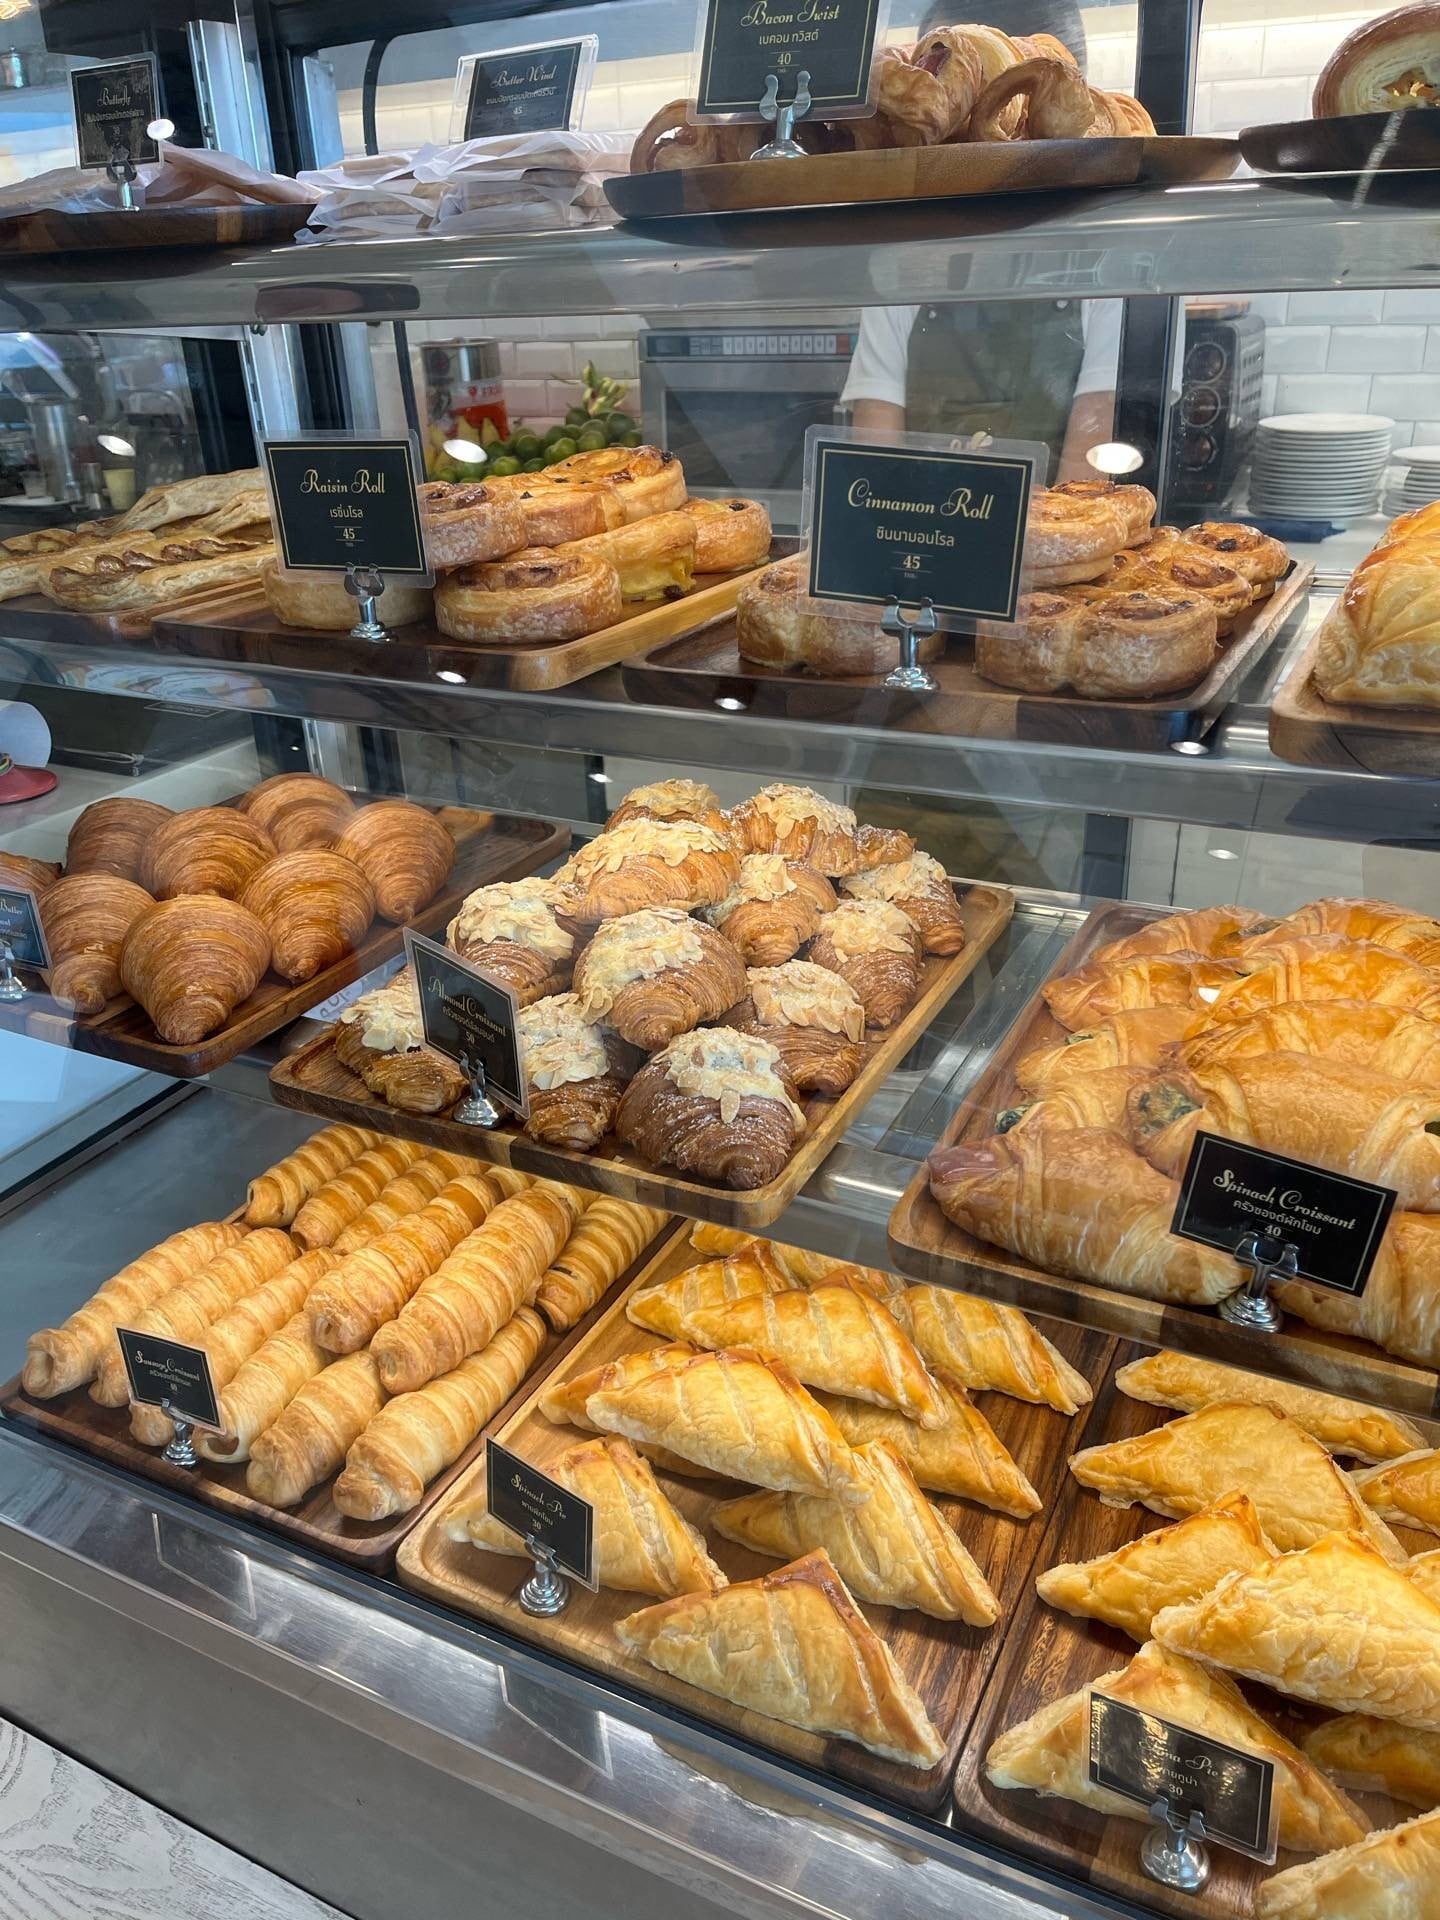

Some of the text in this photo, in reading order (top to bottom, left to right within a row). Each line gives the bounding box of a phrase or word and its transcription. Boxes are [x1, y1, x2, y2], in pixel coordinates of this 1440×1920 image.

[741, 0, 840, 27] Bacon Twist
[759, 29, 820, 45] เบคอน ทวิสต์
[777, 53, 792, 65] 40
[490, 64, 557, 88] Butter Wind
[513, 106, 523, 115] 45
[300, 469, 385, 493] Raisin Roll
[848, 478, 994, 520] Cinnamon Roll
[342, 528, 355, 539] 45
[903, 556, 921, 569] 45
[428, 976, 506, 1037] Almond Croissant
[1213, 1169, 1357, 1230] Spinach Croissant
[1264, 1225, 1281, 1237] 40
[511, 1474, 567, 1520] Spinach Pie
[1185, 1755, 1218, 1777] Pie
[1168, 1784, 1184, 1796] 30
